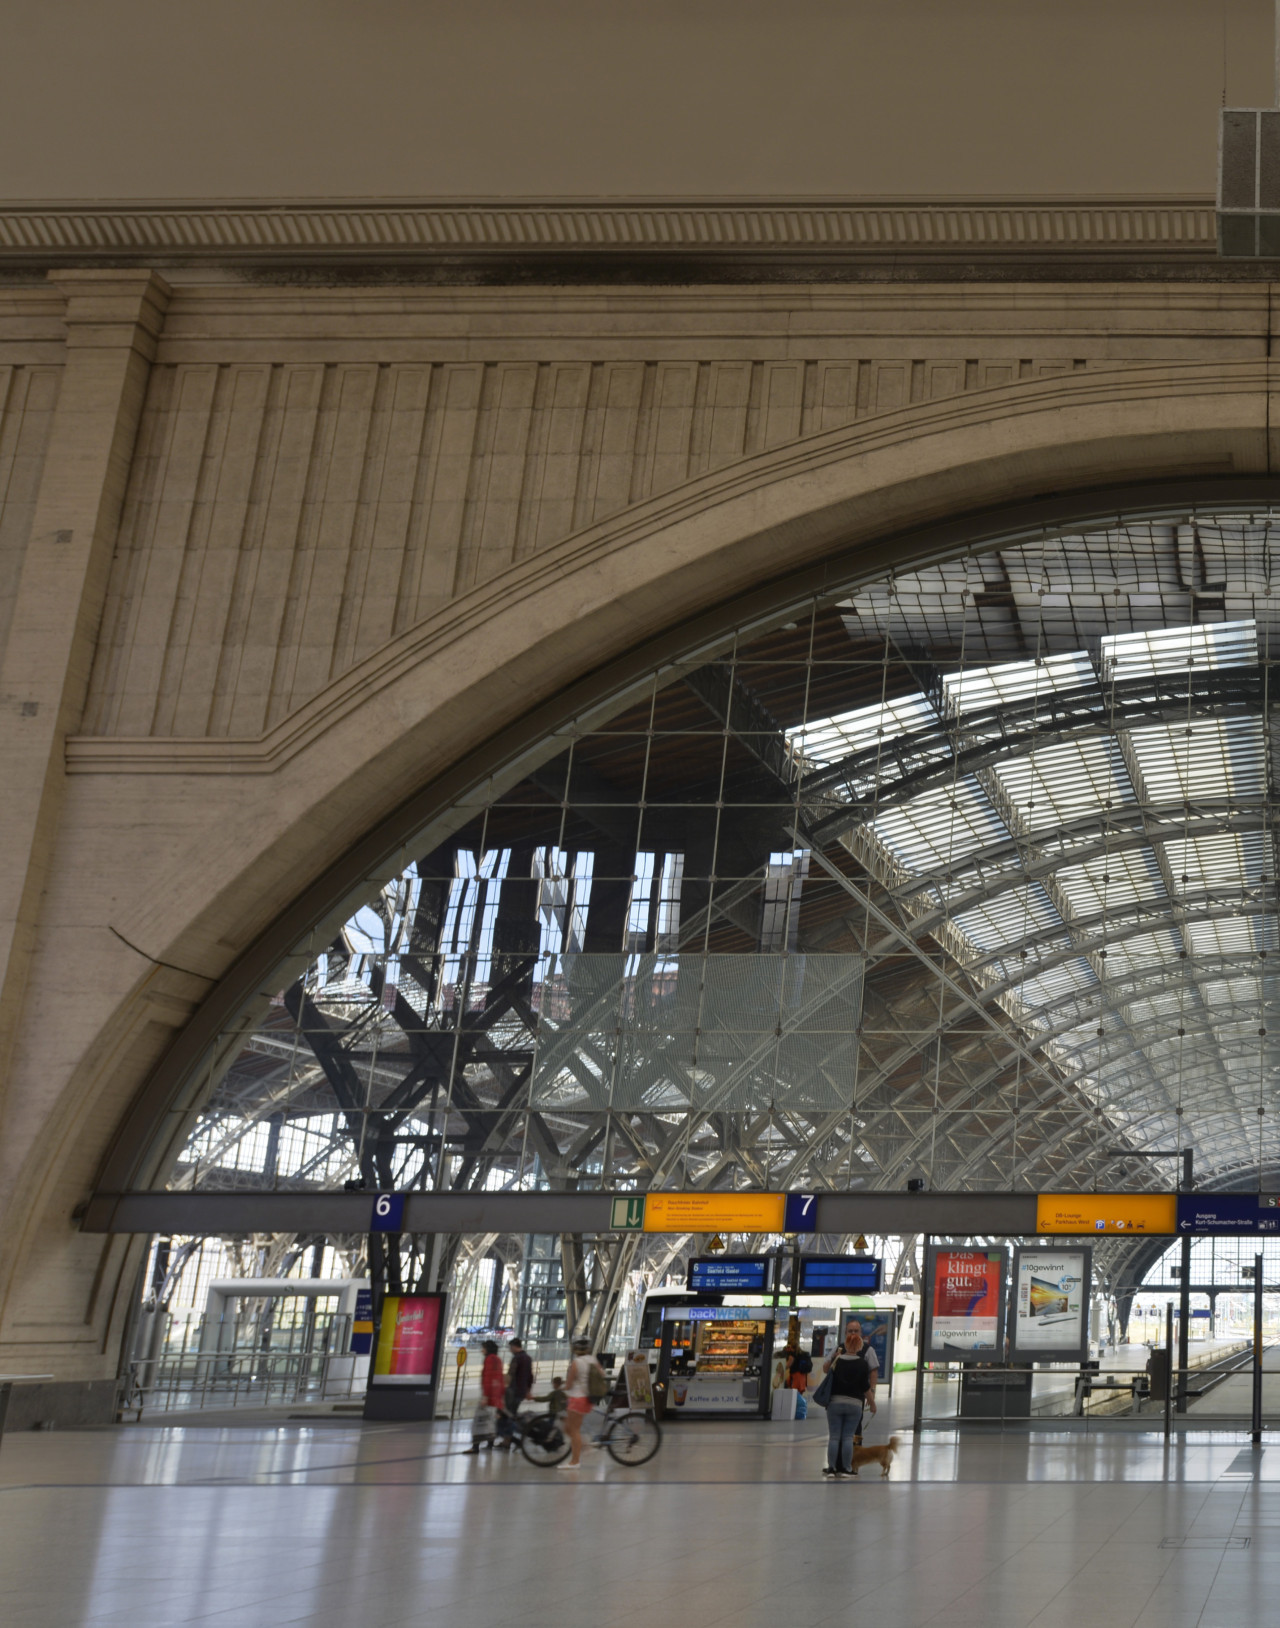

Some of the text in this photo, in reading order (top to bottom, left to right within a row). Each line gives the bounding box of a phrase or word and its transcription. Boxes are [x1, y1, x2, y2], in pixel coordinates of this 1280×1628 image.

[376, 1194, 391, 1216] 6
[801, 1194, 815, 1216] 7
[693, 1264, 699, 1272] 6
[871, 1264, 877, 1272] 7
[948, 1260, 987, 1276] klingt
[1021, 1264, 1065, 1273] #10gewinnt
[946, 1274, 973, 1289] gut.
[934, 1329, 978, 1338] #10gewinnt
